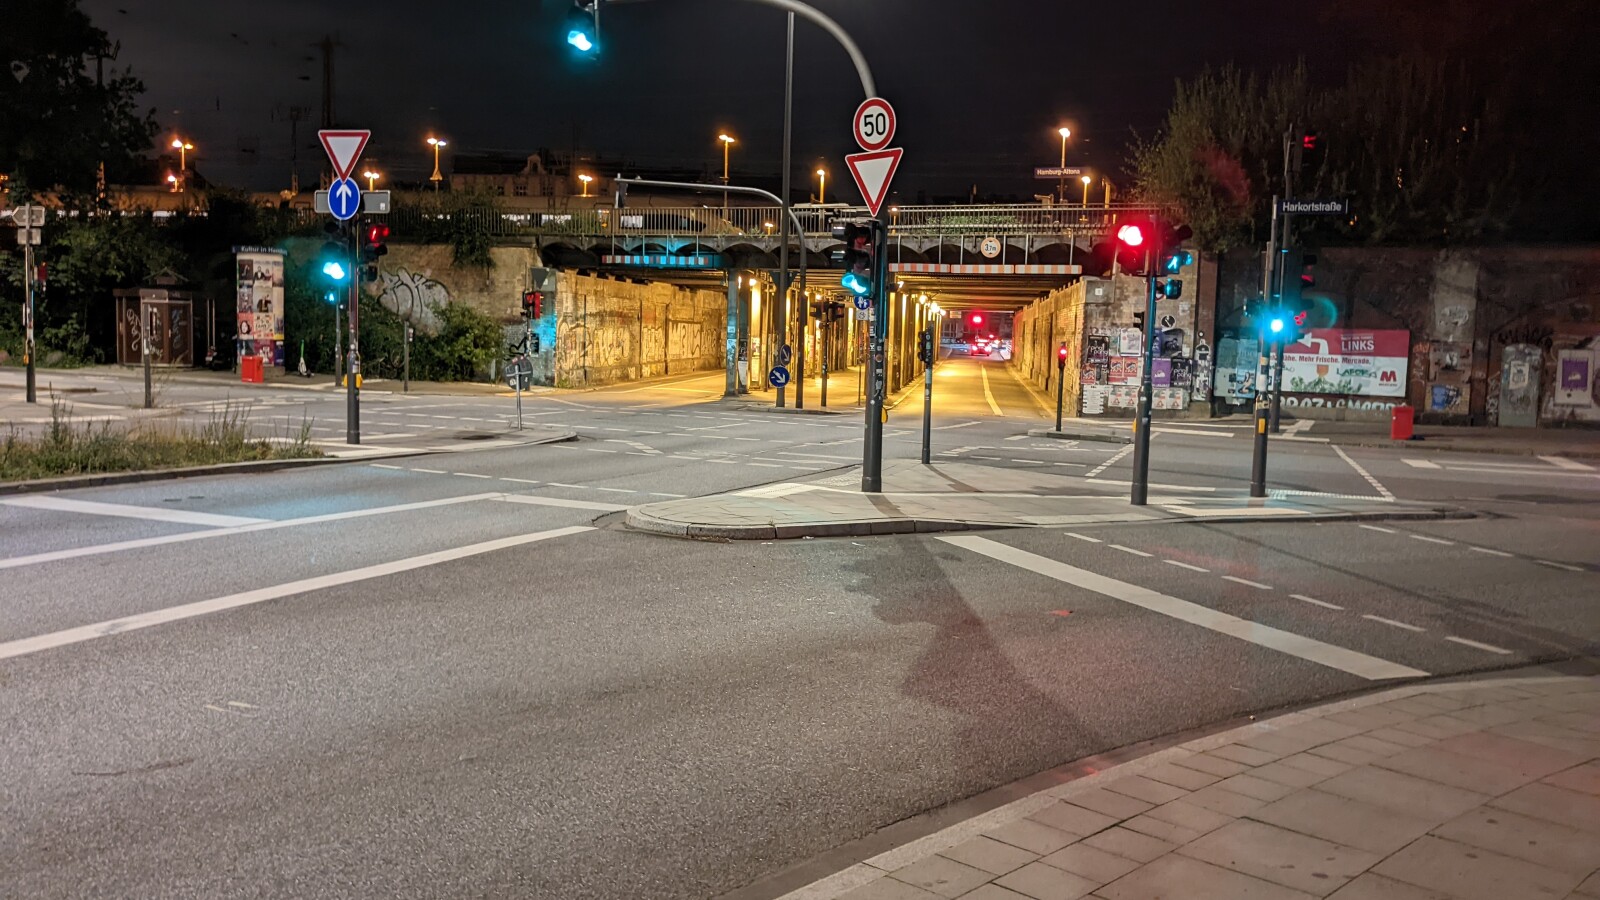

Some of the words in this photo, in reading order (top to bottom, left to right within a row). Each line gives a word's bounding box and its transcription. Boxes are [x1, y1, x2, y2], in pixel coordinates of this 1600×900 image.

[864, 113, 886, 137] 50
[1282, 202, 1342, 211] Harkortstraße
[1341, 340, 1375, 351] LINKS
[1298, 355, 1314, 363] Mehr
